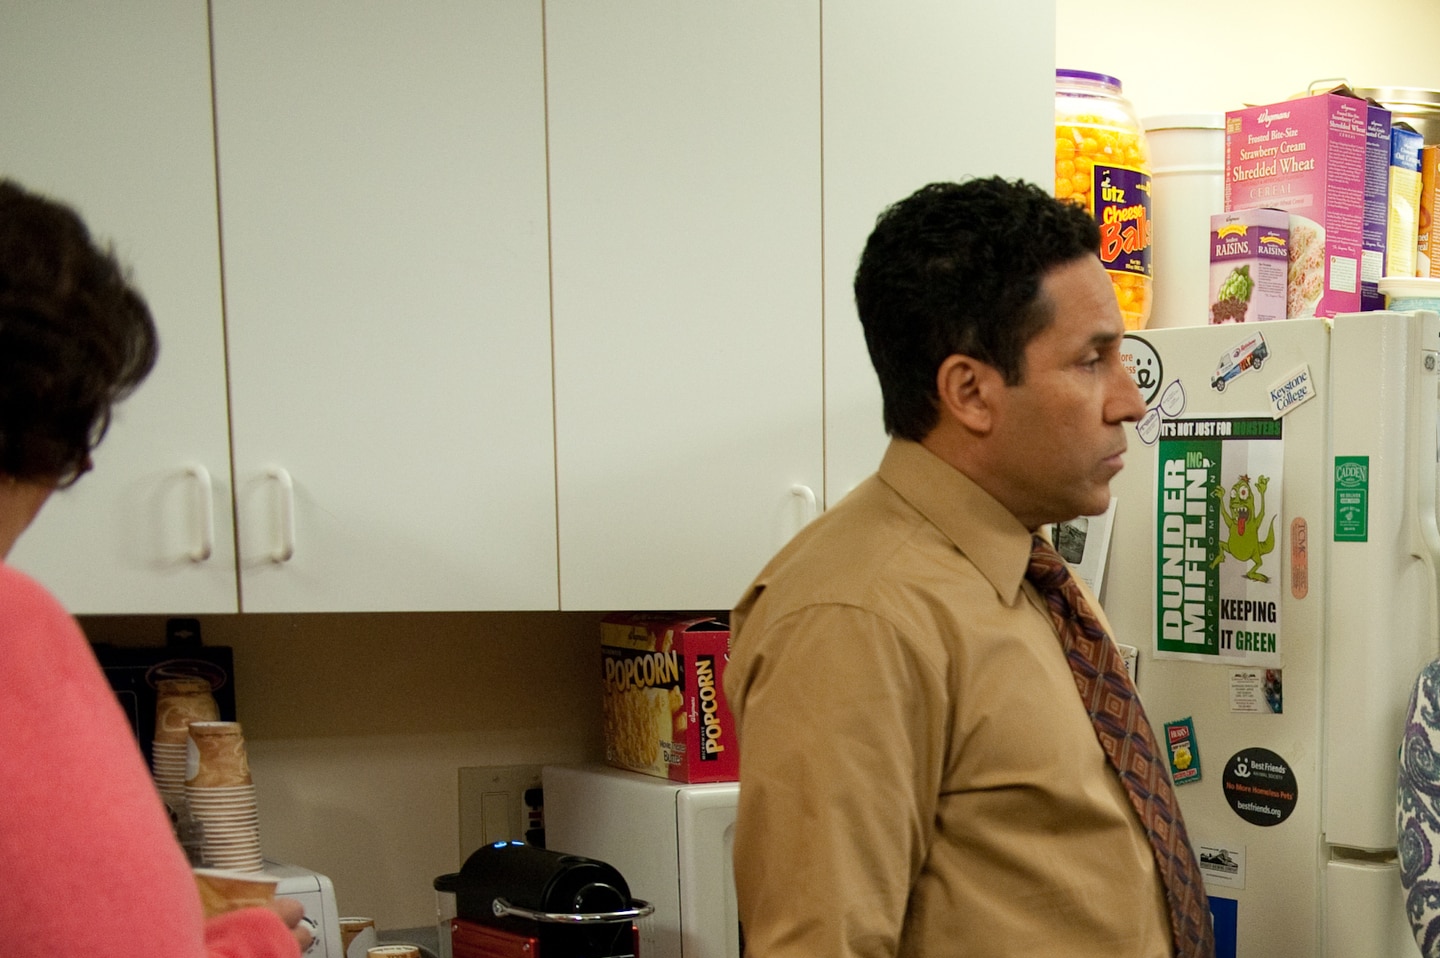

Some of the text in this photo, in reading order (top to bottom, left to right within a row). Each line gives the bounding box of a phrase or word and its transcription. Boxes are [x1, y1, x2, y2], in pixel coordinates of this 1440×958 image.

[1248, 127, 1298, 144] Frosted Bite-Size
[1240, 141, 1306, 161] Strawberry Cream
[1233, 156, 1315, 182] Shredded Wheat
[1250, 183, 1292, 199] CEREAL
[1103, 204, 1143, 225] Cheese
[1216, 241, 1249, 257] RAISINS
[1258, 246, 1288, 257] RAISINS
[1270, 372, 1307, 402] Keystone
[1276, 386, 1308, 411] College
[1161, 422, 1177, 437] IT'S
[1177, 422, 1194, 437] NOT
[1194, 421, 1215, 436] JUST
[1216, 421, 1232, 436] FOR
[1187, 451, 1203, 468] INC
[1208, 460, 1217, 561] COMPANY
[1162, 459, 1186, 640] DUNDER
[1221, 599, 1276, 623] KEEPING
[1221, 630, 1276, 653] IT GREEN
[605, 650, 680, 693] POPCORN
[695, 659, 725, 754] POPCORN
[1250, 760, 1286, 774] Best Friends
[1226, 782, 1235, 790] No
[1236, 783, 1252, 792] More
[1252, 786, 1280, 798] Homeless
[1237, 801, 1282, 818] bestfriends.org
